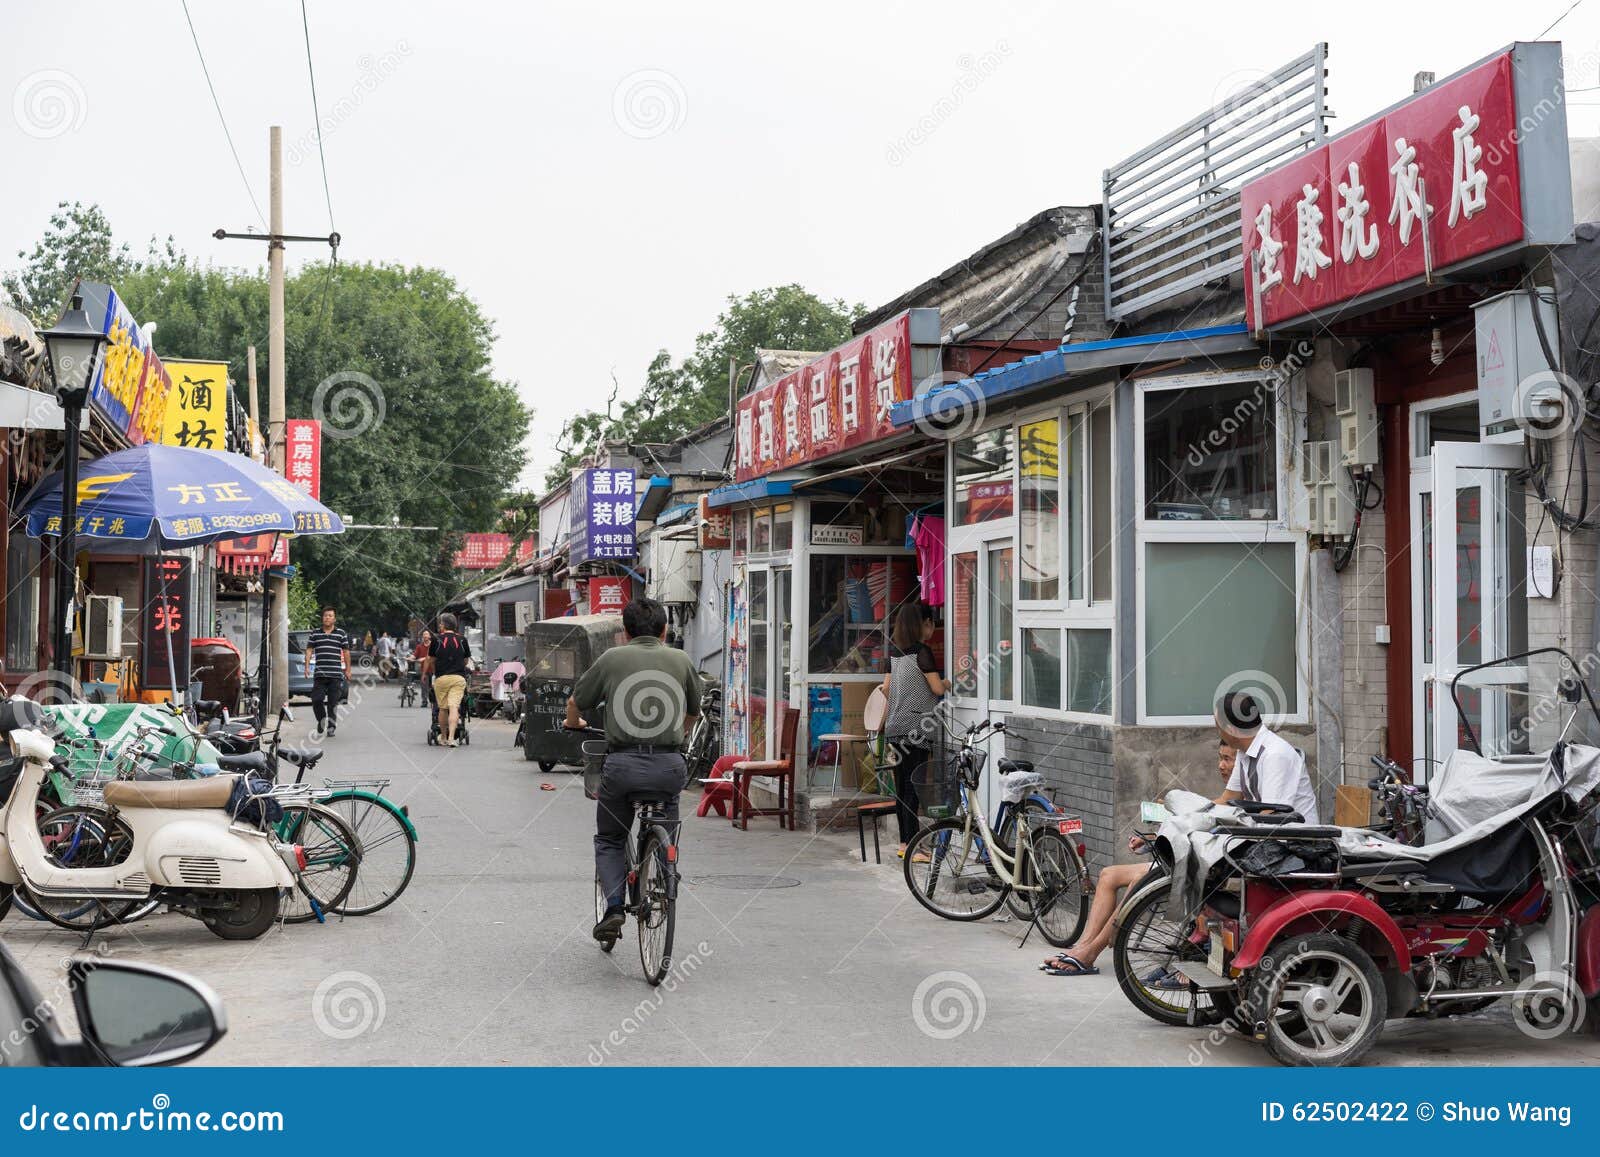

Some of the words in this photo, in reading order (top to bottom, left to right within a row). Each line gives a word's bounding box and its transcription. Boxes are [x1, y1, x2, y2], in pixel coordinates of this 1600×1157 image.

[1254, 105, 1489, 294] 圣康洗衣店
[738, 339, 896, 470] 烟酒食品百货
[167, 481, 253, 505] 方正
[592, 470, 633, 495] 盖房
[592, 501, 633, 526] 装修
[593, 533, 633, 545] 水电改造
